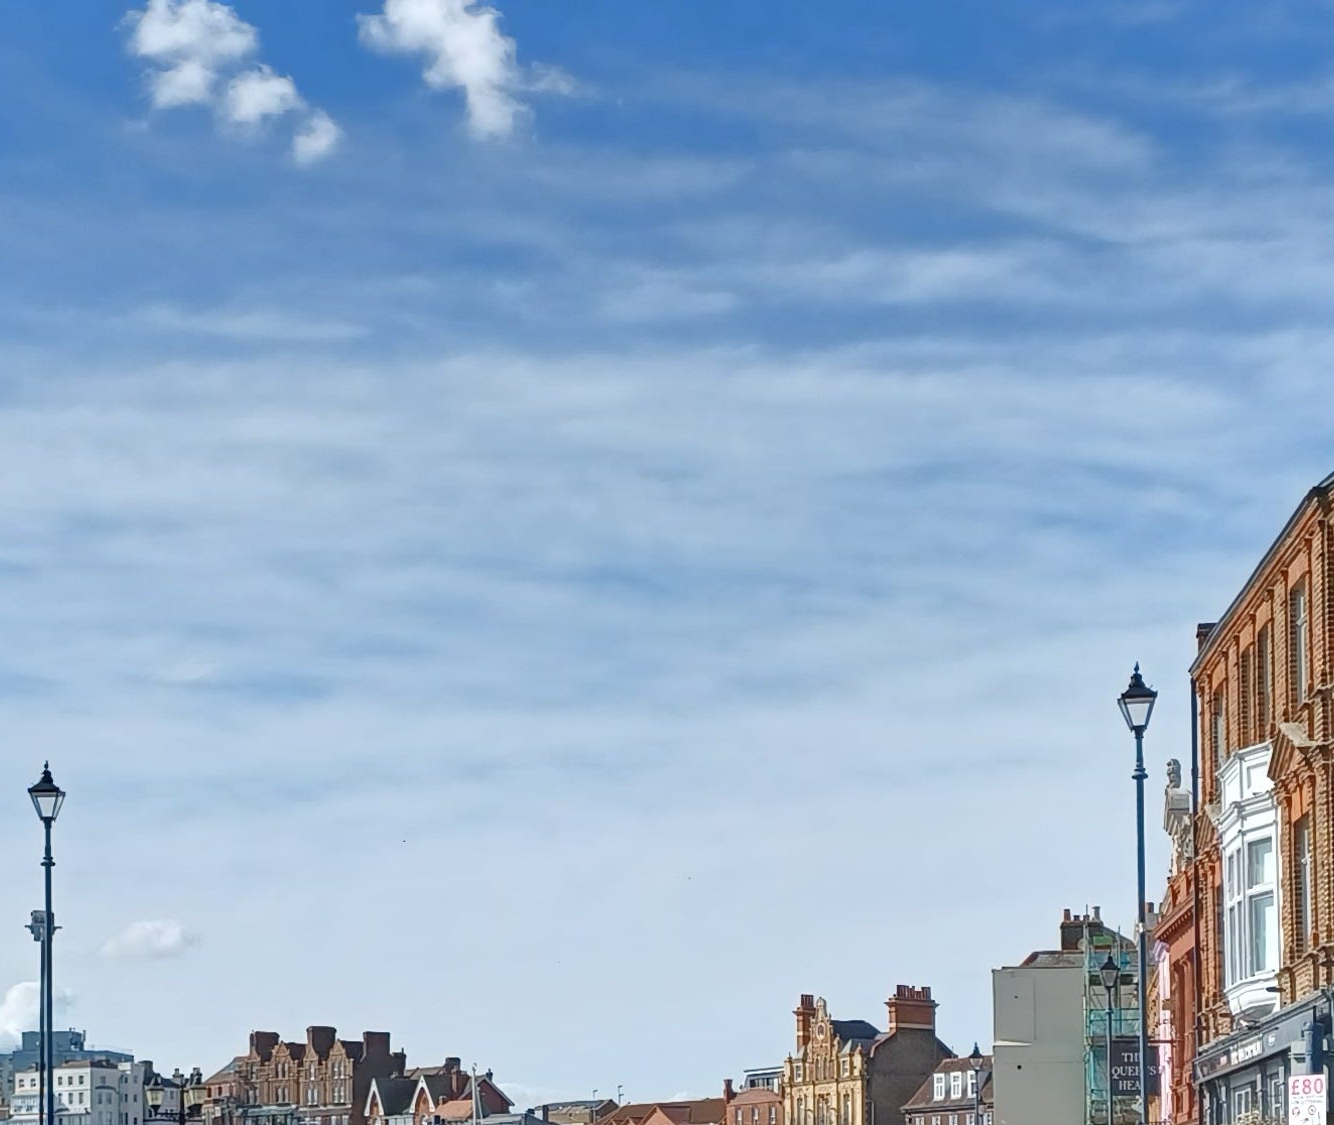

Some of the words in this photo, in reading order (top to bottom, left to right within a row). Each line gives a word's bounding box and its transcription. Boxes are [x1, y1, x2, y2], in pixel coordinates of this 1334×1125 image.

[1121, 1052, 1140, 1063] TH
[1111, 1064, 1157, 1080] QUE'S
[1119, 1080, 1142, 1091] HEA
[1291, 1078, 1324, 1096] £80
